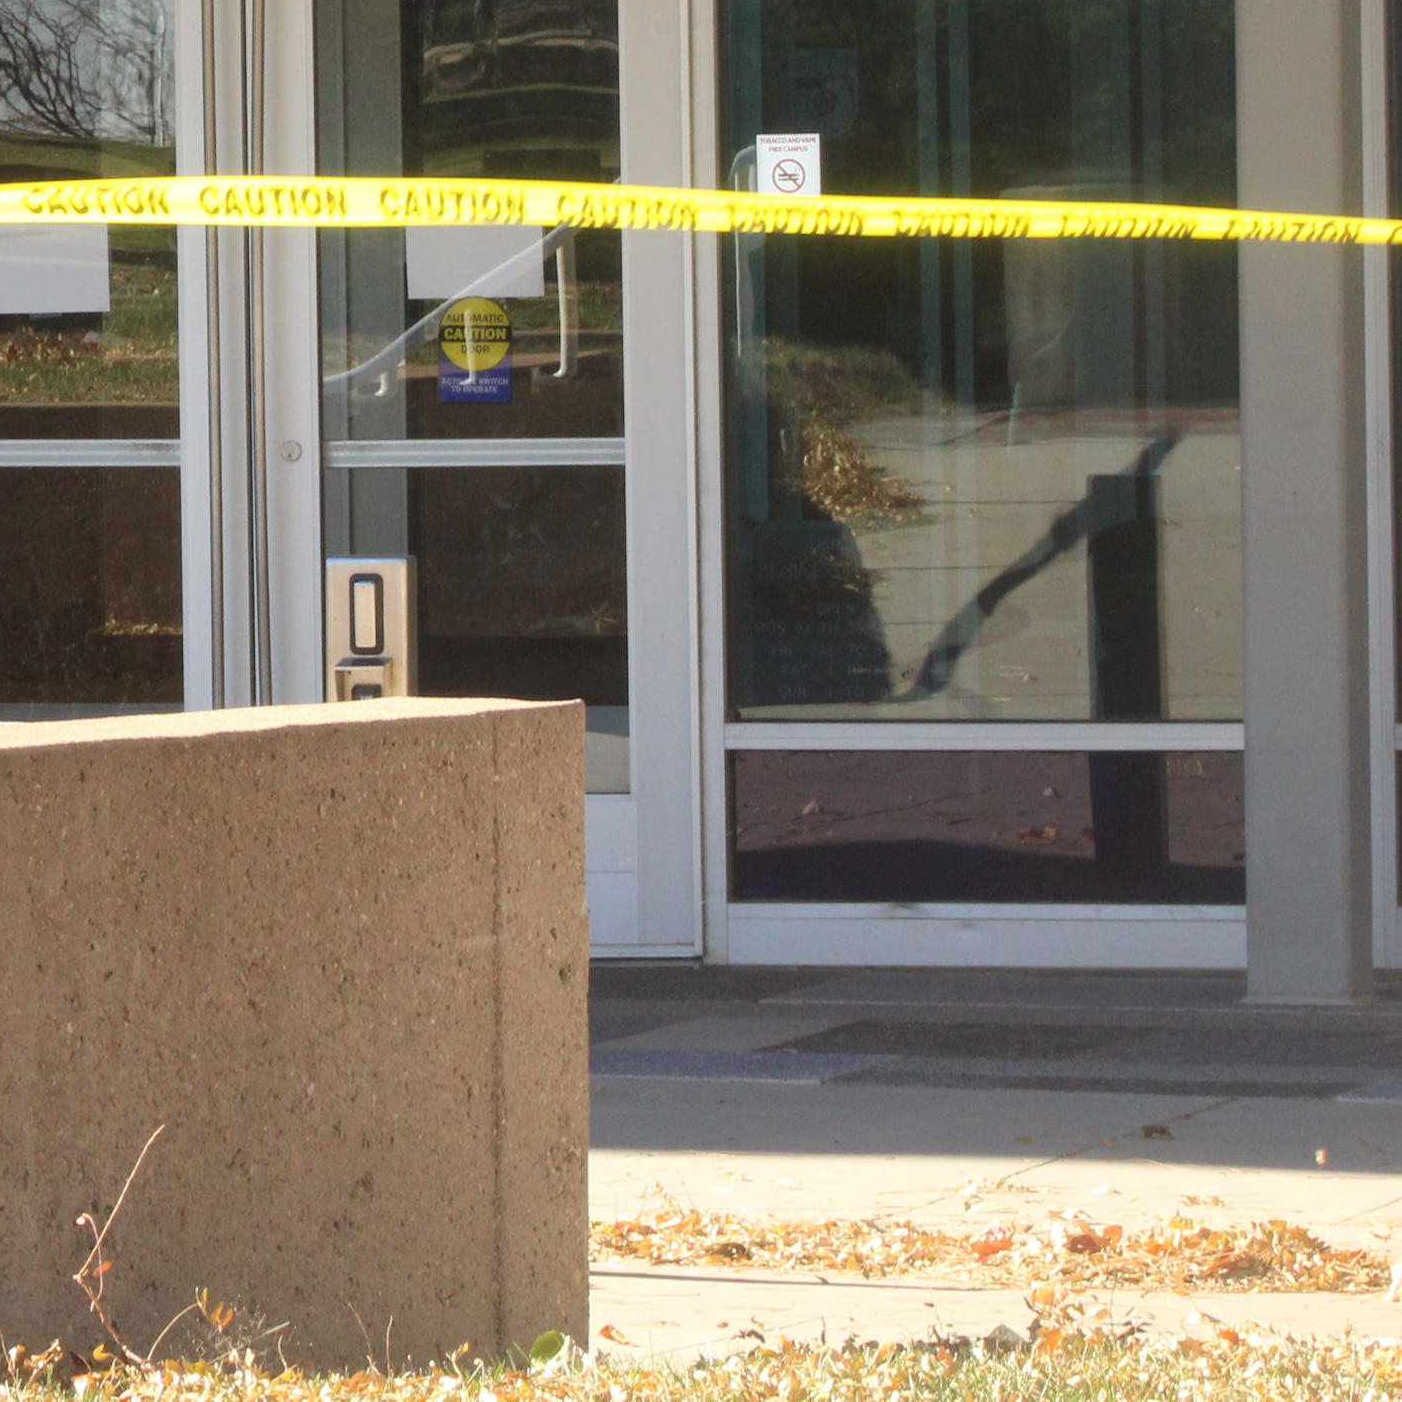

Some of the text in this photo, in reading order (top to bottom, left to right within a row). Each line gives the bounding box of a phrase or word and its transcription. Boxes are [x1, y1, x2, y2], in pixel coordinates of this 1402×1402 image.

[22, 185, 171, 216] CAUTION
[198, 184, 349, 217] CAUTION
[378, 184, 526, 226] CAUTION
[556, 190, 700, 231] CAUTION
[443, 327, 507, 340] CAUTION
[478, 377, 509, 385] SWITCH
